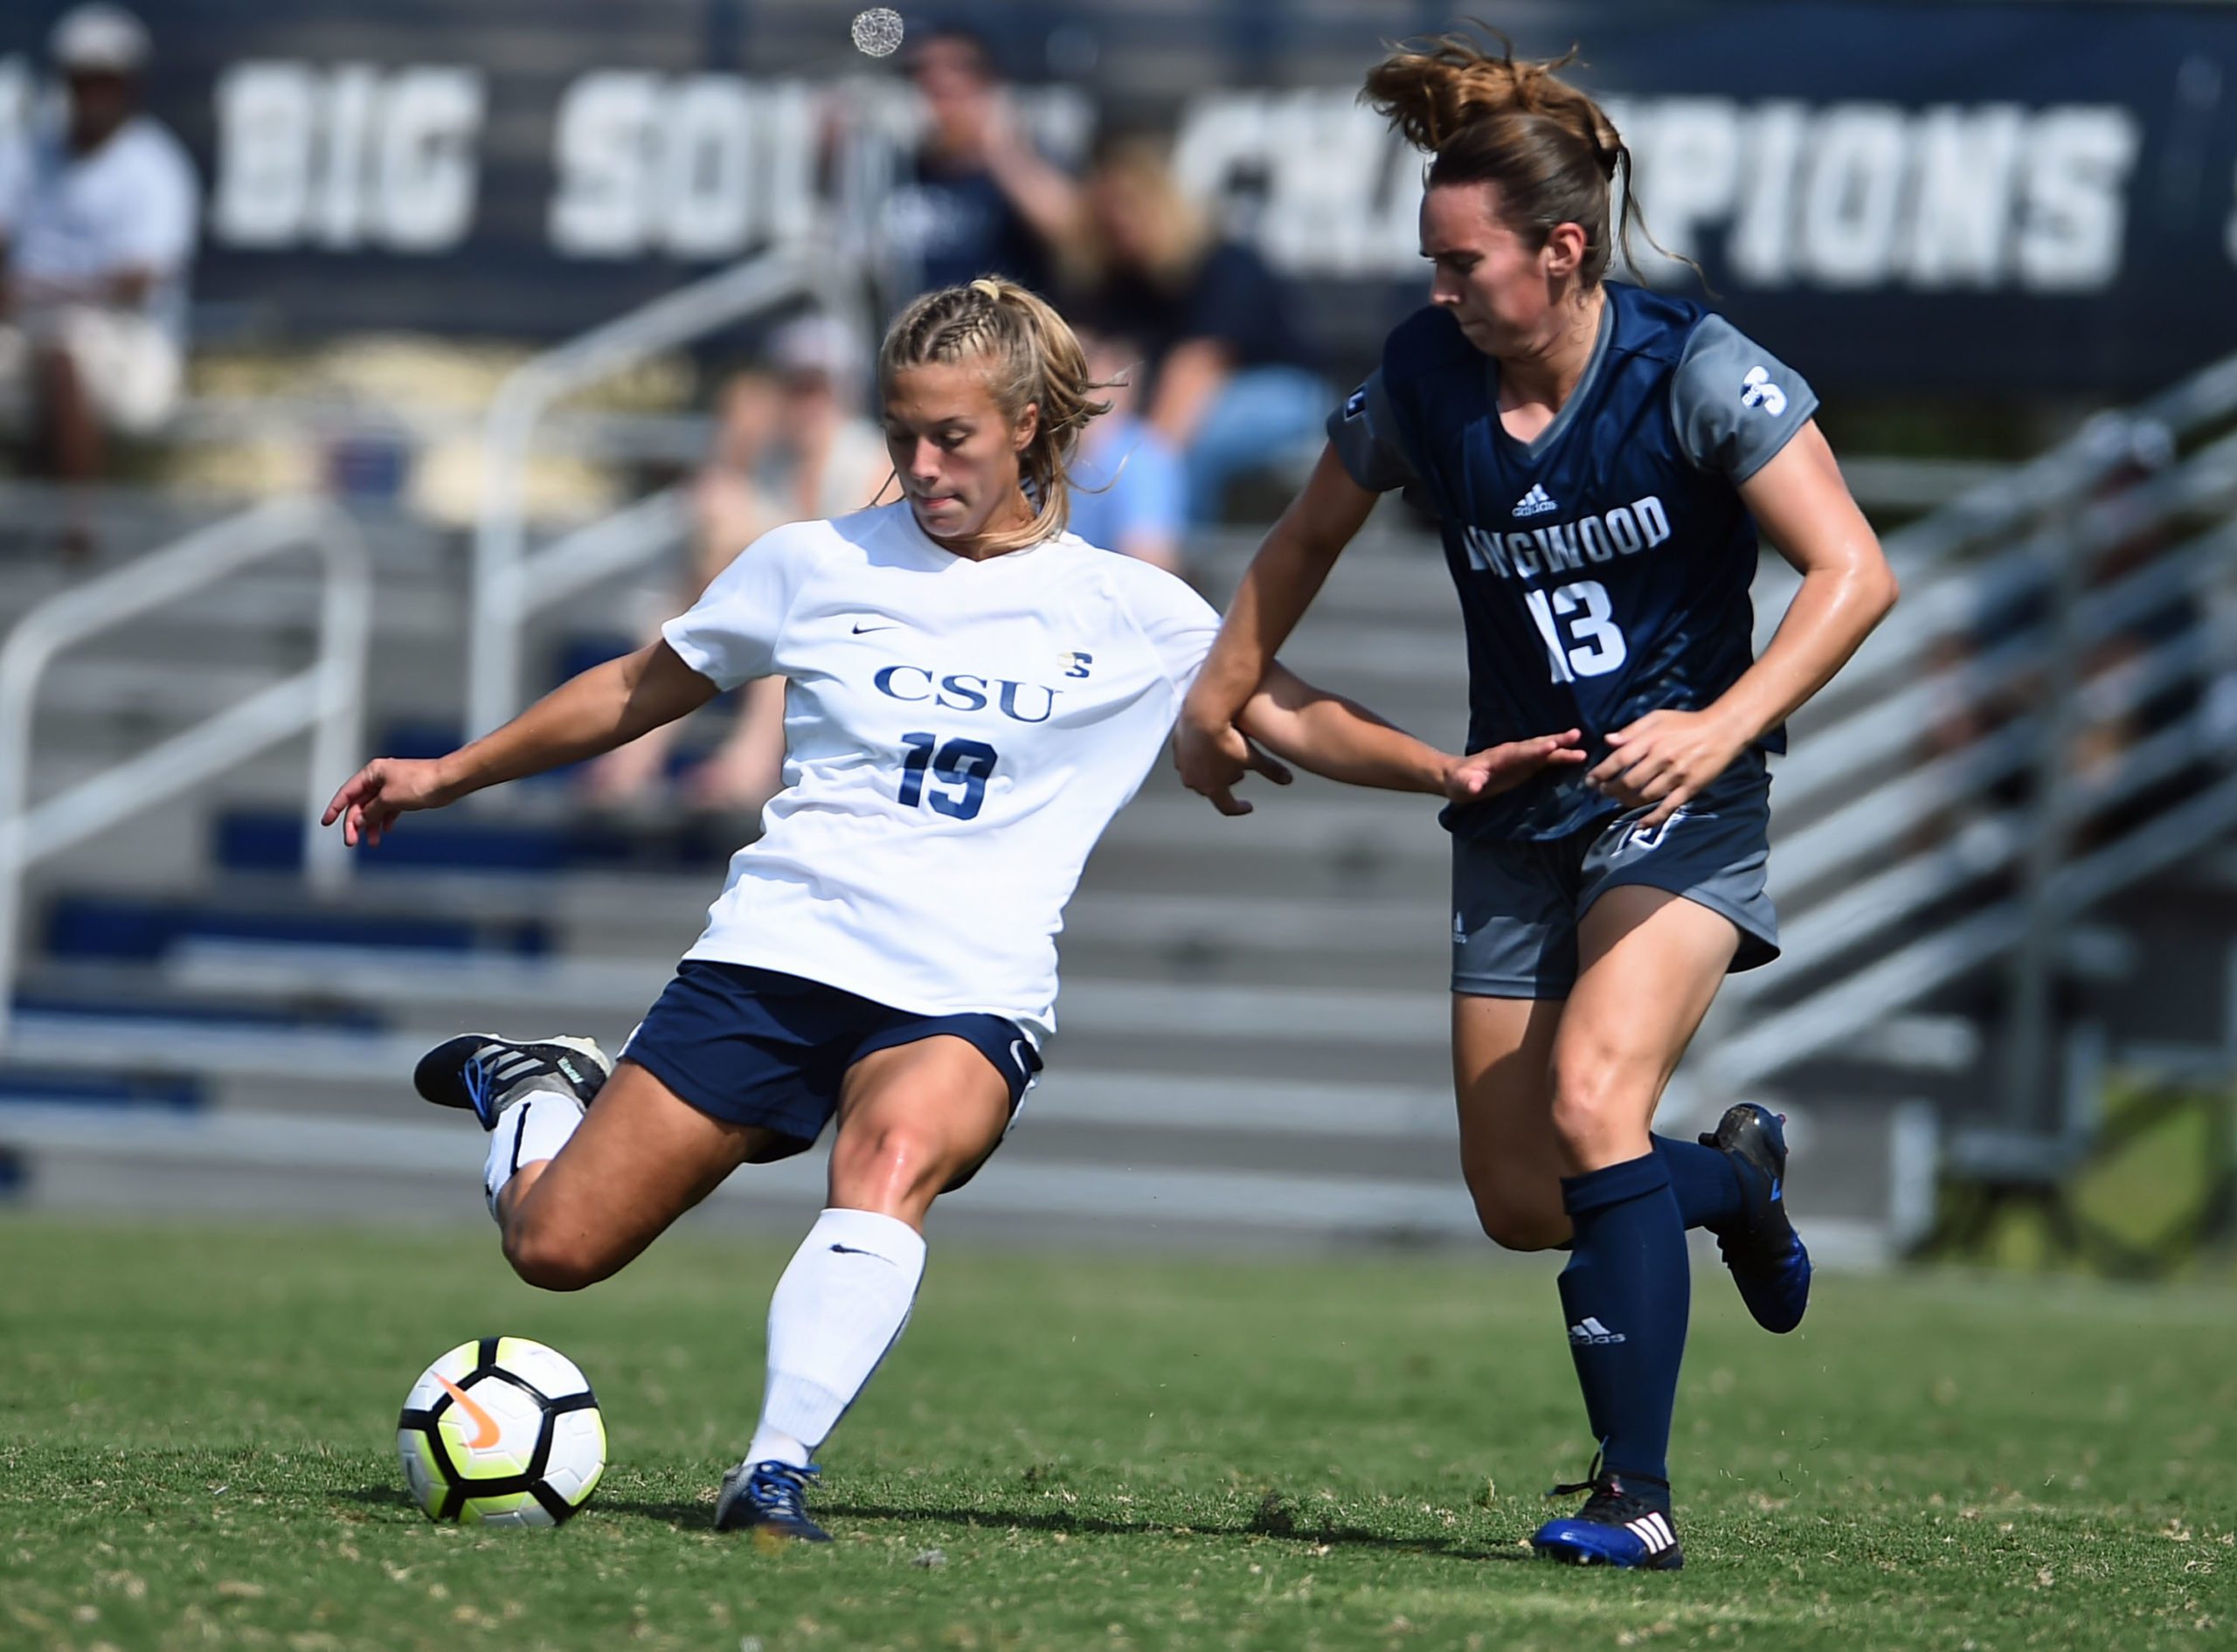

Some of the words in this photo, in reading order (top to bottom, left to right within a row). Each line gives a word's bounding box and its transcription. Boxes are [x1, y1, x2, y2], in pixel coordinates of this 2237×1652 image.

[215, 61, 484, 252] BIG
[1169, 89, 2139, 291] CHPIONS
[1462, 495, 1672, 578] NGWOOD
[1512, 501, 1558, 517] adidas
[1524, 580, 1627, 684] 13
[874, 665, 1063, 723] CSU
[898, 731, 998, 821] 19
[1570, 1332, 1626, 1345] idas
